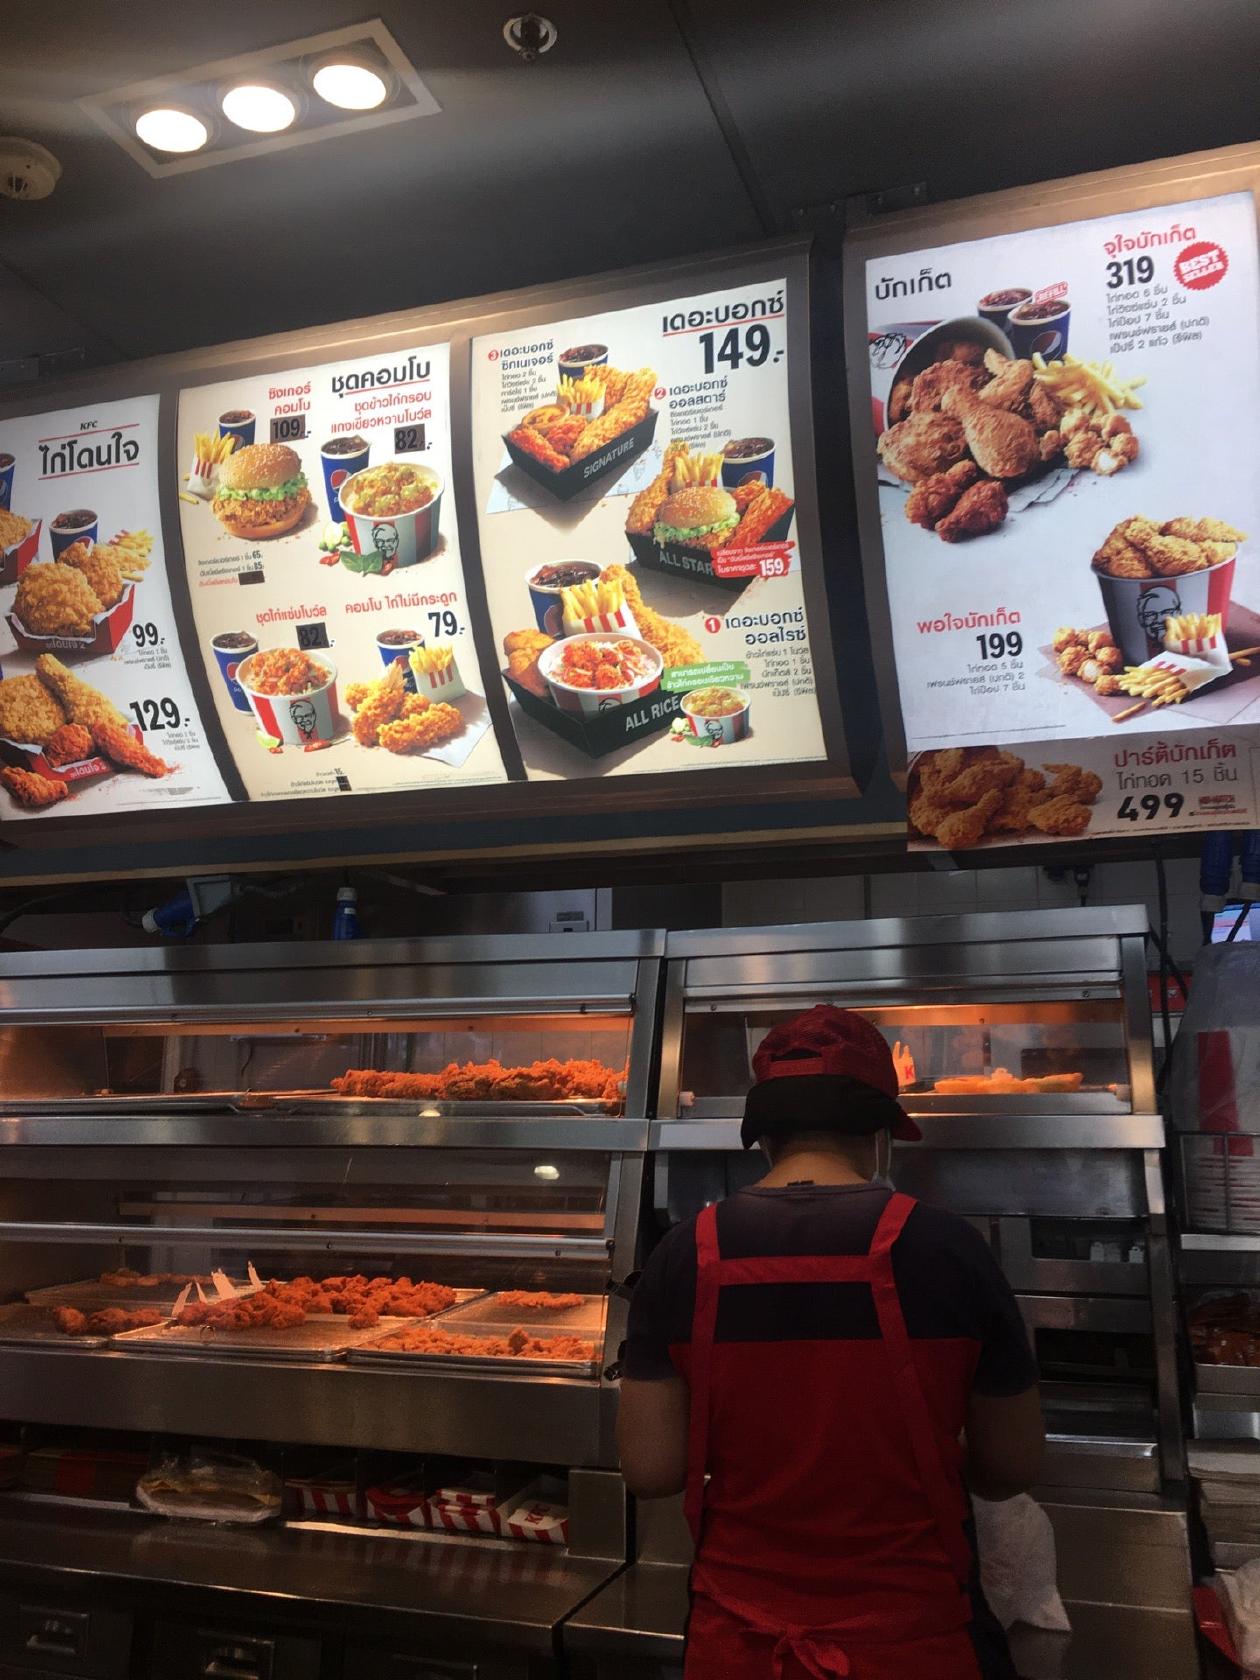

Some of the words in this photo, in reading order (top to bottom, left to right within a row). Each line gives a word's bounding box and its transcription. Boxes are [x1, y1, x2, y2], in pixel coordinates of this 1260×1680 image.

[1103, 223, 1196, 258] จุใจบักเก็ต
[875, 267, 952, 300] บักเก็ต
[1106, 255, 1155, 289] 319
[1106, 290, 1139, 303] ไก่ทอด
[1153, 284, 1168, 295] ชิ้น
[1161, 298, 1168, 307] 2
[1172, 293, 1187, 305] ชิ้น
[662, 290, 784, 332] เดอะบอกซ์
[1145, 313, 1151, 321] 7
[1155, 308, 1169, 320] ชิ้น
[500, 338, 554, 358] เดอะบอกซ์
[699, 323, 784, 375] 149.-
[1138, 340, 1145, 349] 2
[502, 352, 554, 371] ซิกเนเจอร์
[331, 356, 431, 398] ชุดคอมโบ
[669, 375, 728, 396] เดอะบอกซ์
[268, 381, 311, 400] ซิงเกอร์
[354, 391, 432, 415] ชุดข้าวไก่กรอบ
[669, 389, 726, 409] ออลสตาร์
[274, 398, 311, 415] คอมโบ
[80, 420, 98, 431] KFC
[331, 407, 432, 433] แกงเขียวหวานโบว์ล
[38, 431, 140, 475] ไก่โดนใจ
[583, 437, 635, 479] SIGNATURE
[659, 550, 681, 567] ALL
[681, 556, 714, 576] STAR
[345, 599, 382, 614] คอมโบ
[387, 591, 458, 612] ไก่ไม่มีกระดูก
[428, 610, 466, 638] 79.-
[725, 607, 804, 629] เดอะบอกซ์
[917, 607, 1021, 634] พอใจบักเก็ต
[132, 622, 166, 648] 99.-
[745, 626, 806, 645] ออลไรซ์
[976, 631, 1023, 660] 199
[967, 664, 998, 674] ไก่ทอด
[1018, 672, 1024, 680] 2
[129, 697, 190, 731] 129.-
[625, 710, 650, 732] ALL
[651, 695, 679, 719] RICE
[1114, 738, 1237, 768] ปาร์ตี้บักเก็ต
[1116, 771, 1172, 790] ไก่ทอด
[1183, 769, 1204, 784] 15
[1213, 762, 1238, 782] ชิ้น
